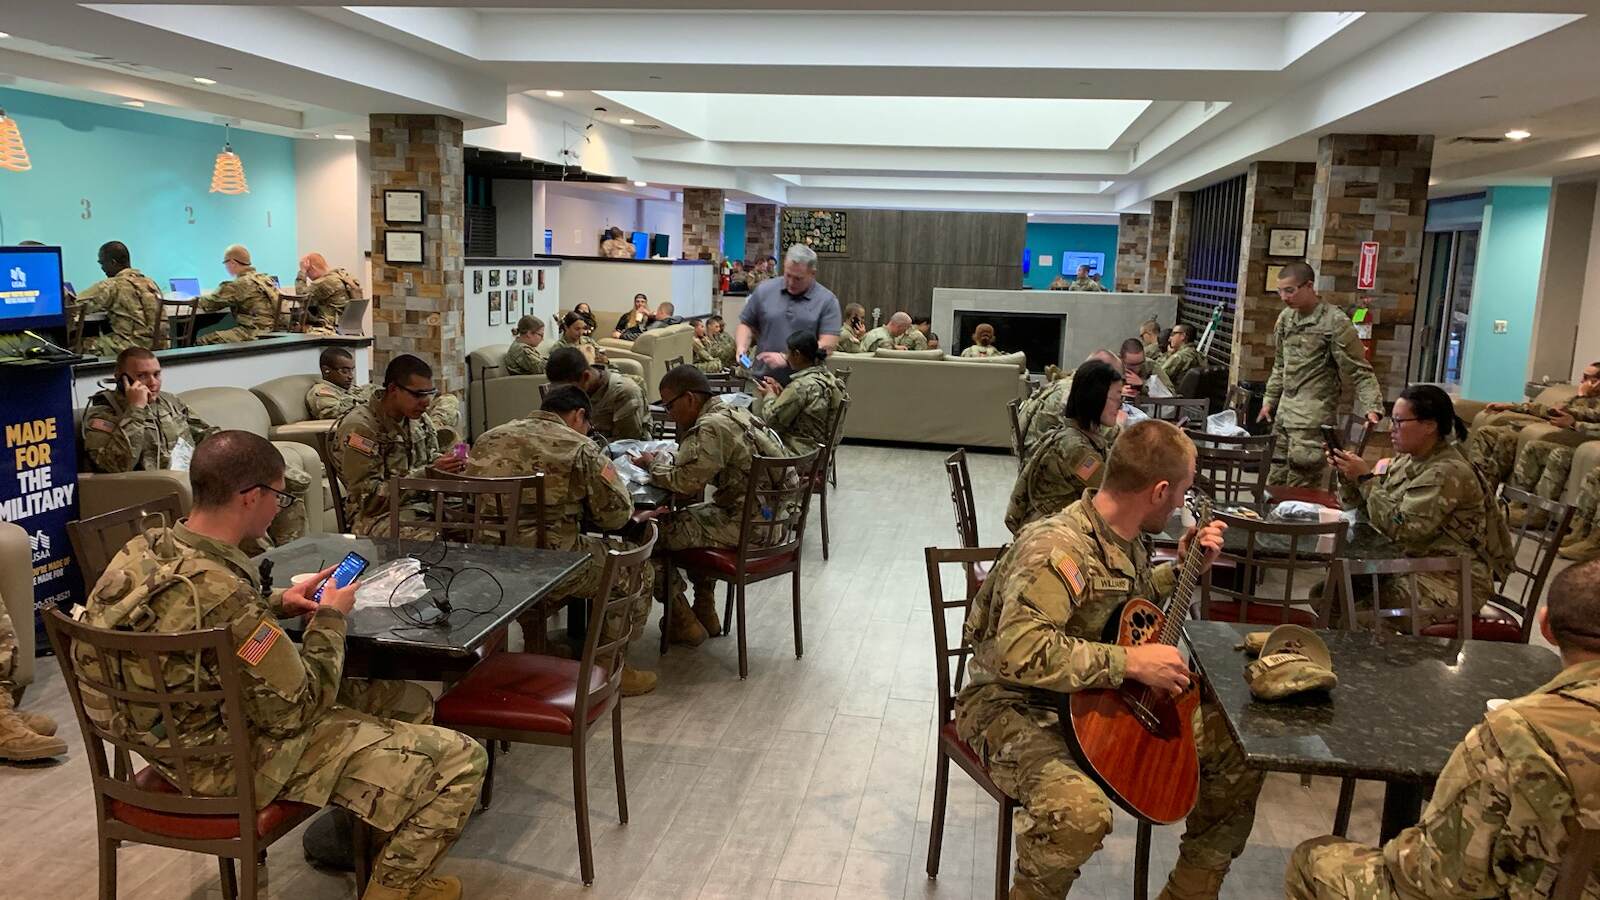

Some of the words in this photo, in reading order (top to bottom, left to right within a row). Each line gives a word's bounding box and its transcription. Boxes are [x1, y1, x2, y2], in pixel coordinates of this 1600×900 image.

[80, 198, 91, 220] 3
[184, 206, 196, 225] 2
[5, 417, 57, 448] MADE
[15, 443, 52, 470] FOR
[16, 466, 52, 494] THE
[0, 483, 75, 522] MILITARY
